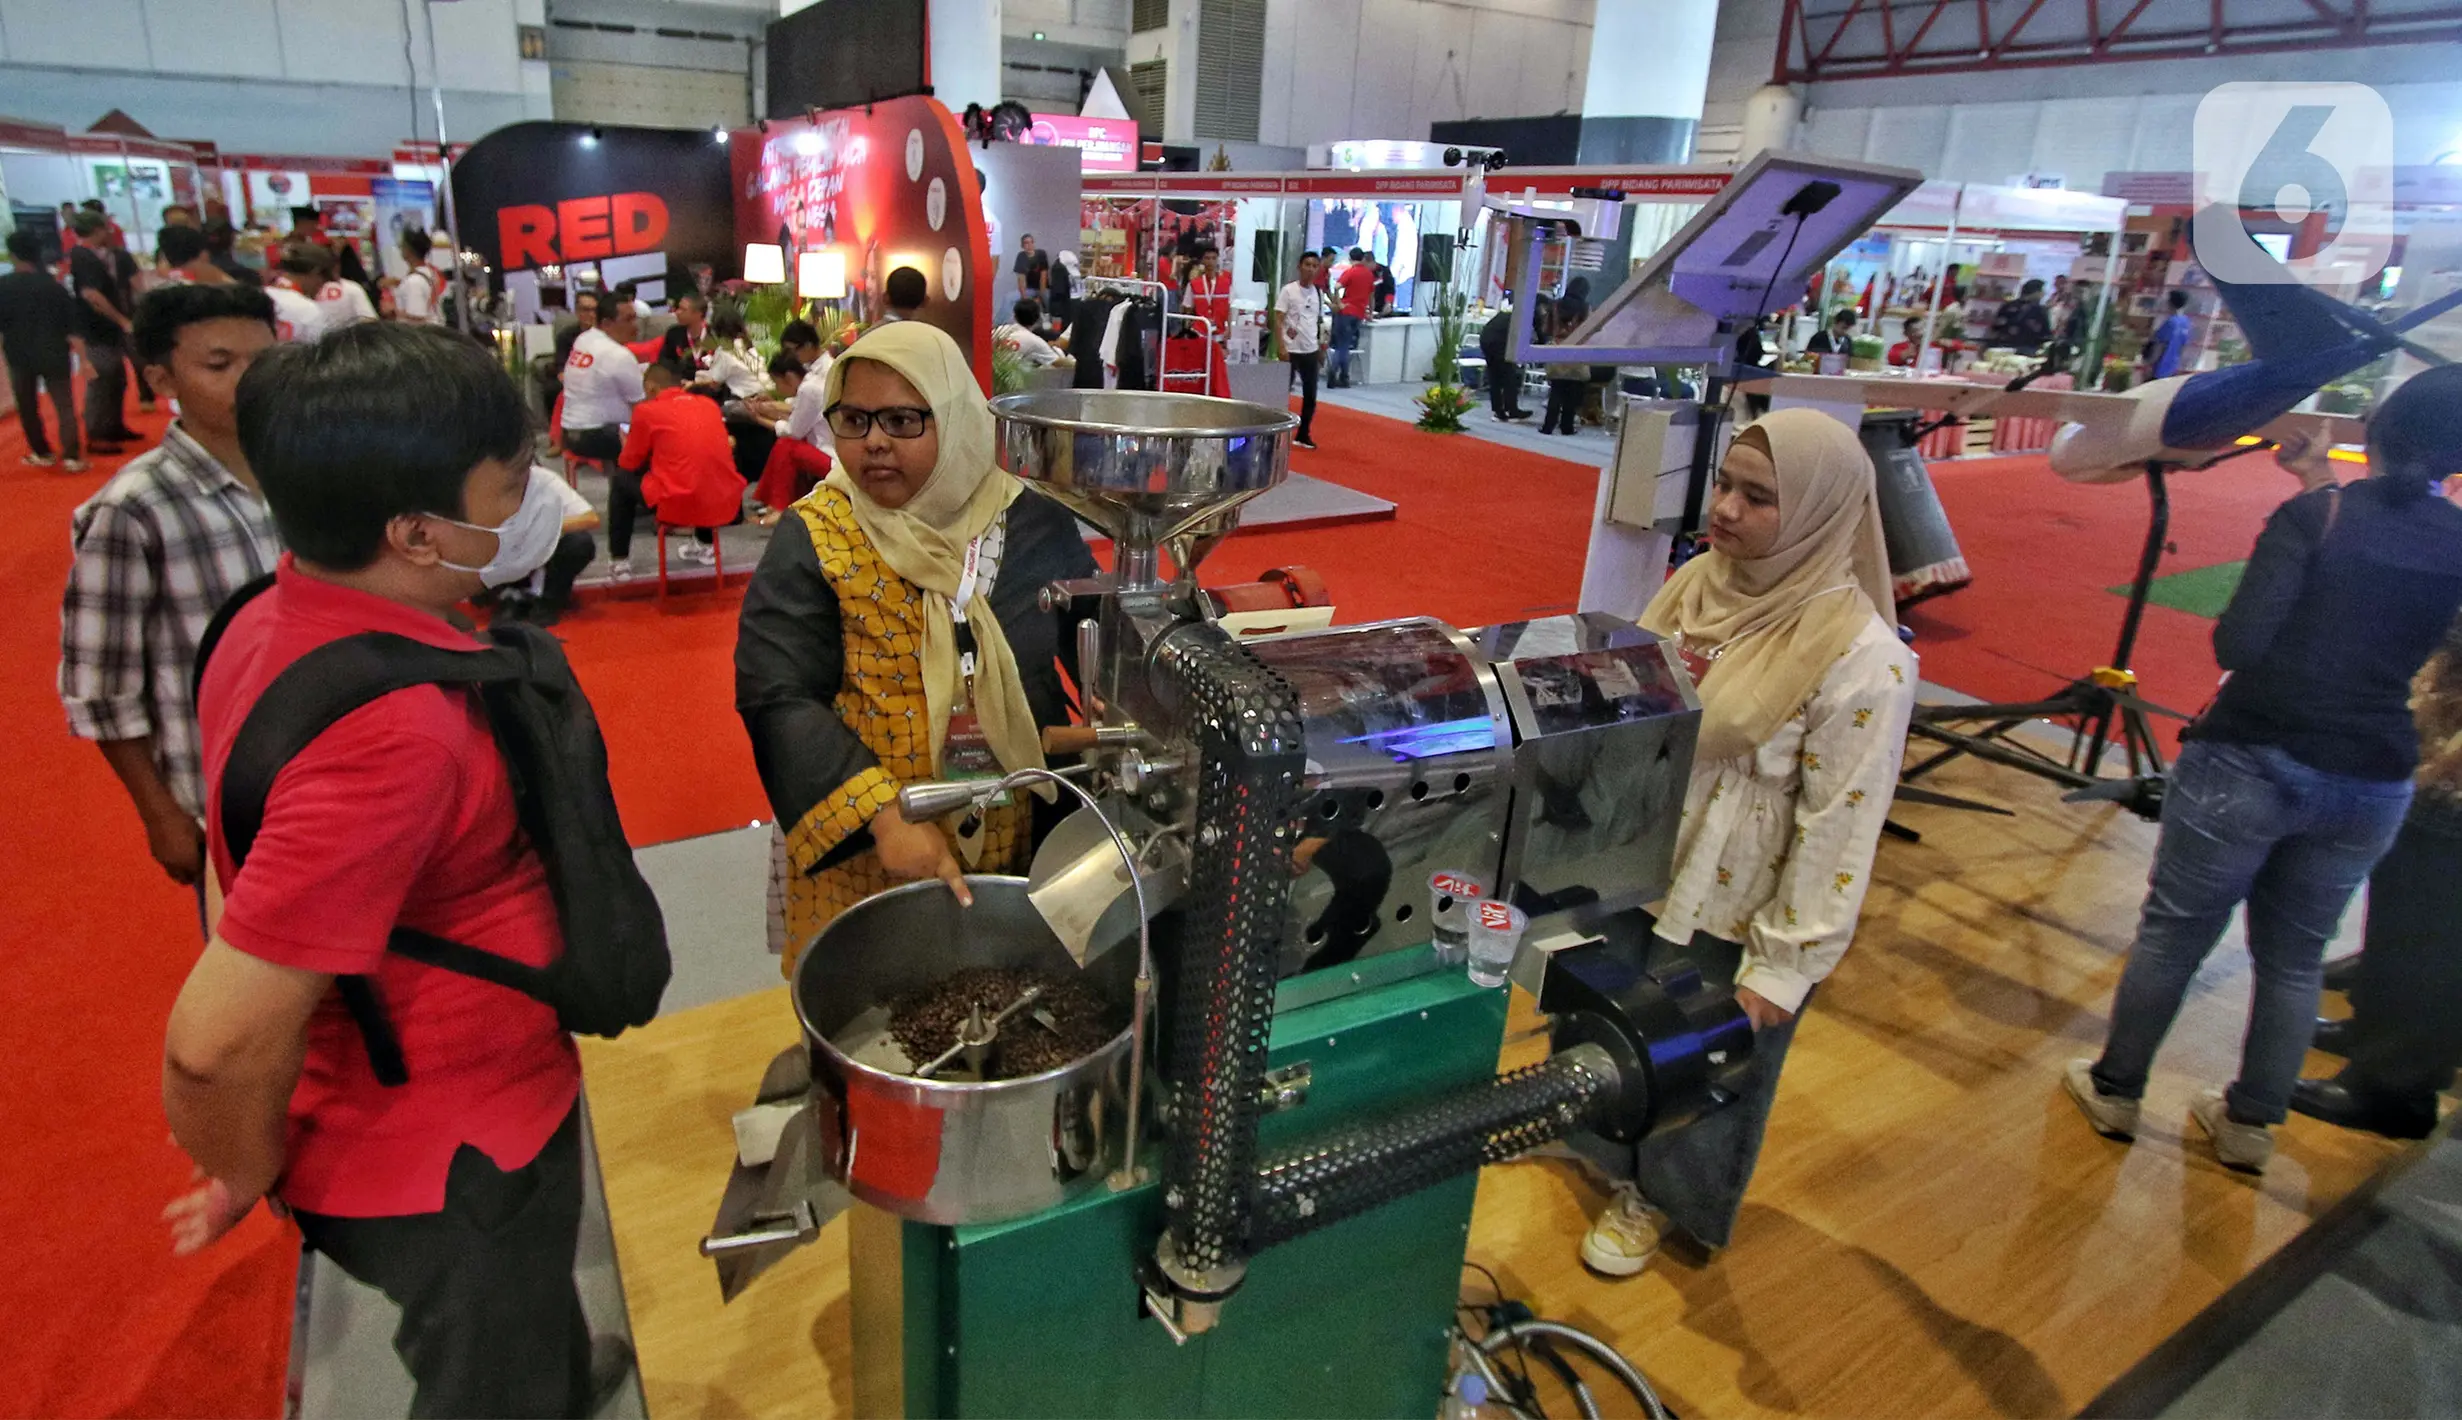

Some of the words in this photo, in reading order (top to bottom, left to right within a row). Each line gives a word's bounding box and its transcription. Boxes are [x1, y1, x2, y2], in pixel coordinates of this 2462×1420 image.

[807, 168, 844, 203] DEPAN
[1622, 179, 1659, 190] BIDANG
[1661, 178, 1723, 190] PARIWISATA
[497, 191, 670, 270] RED
